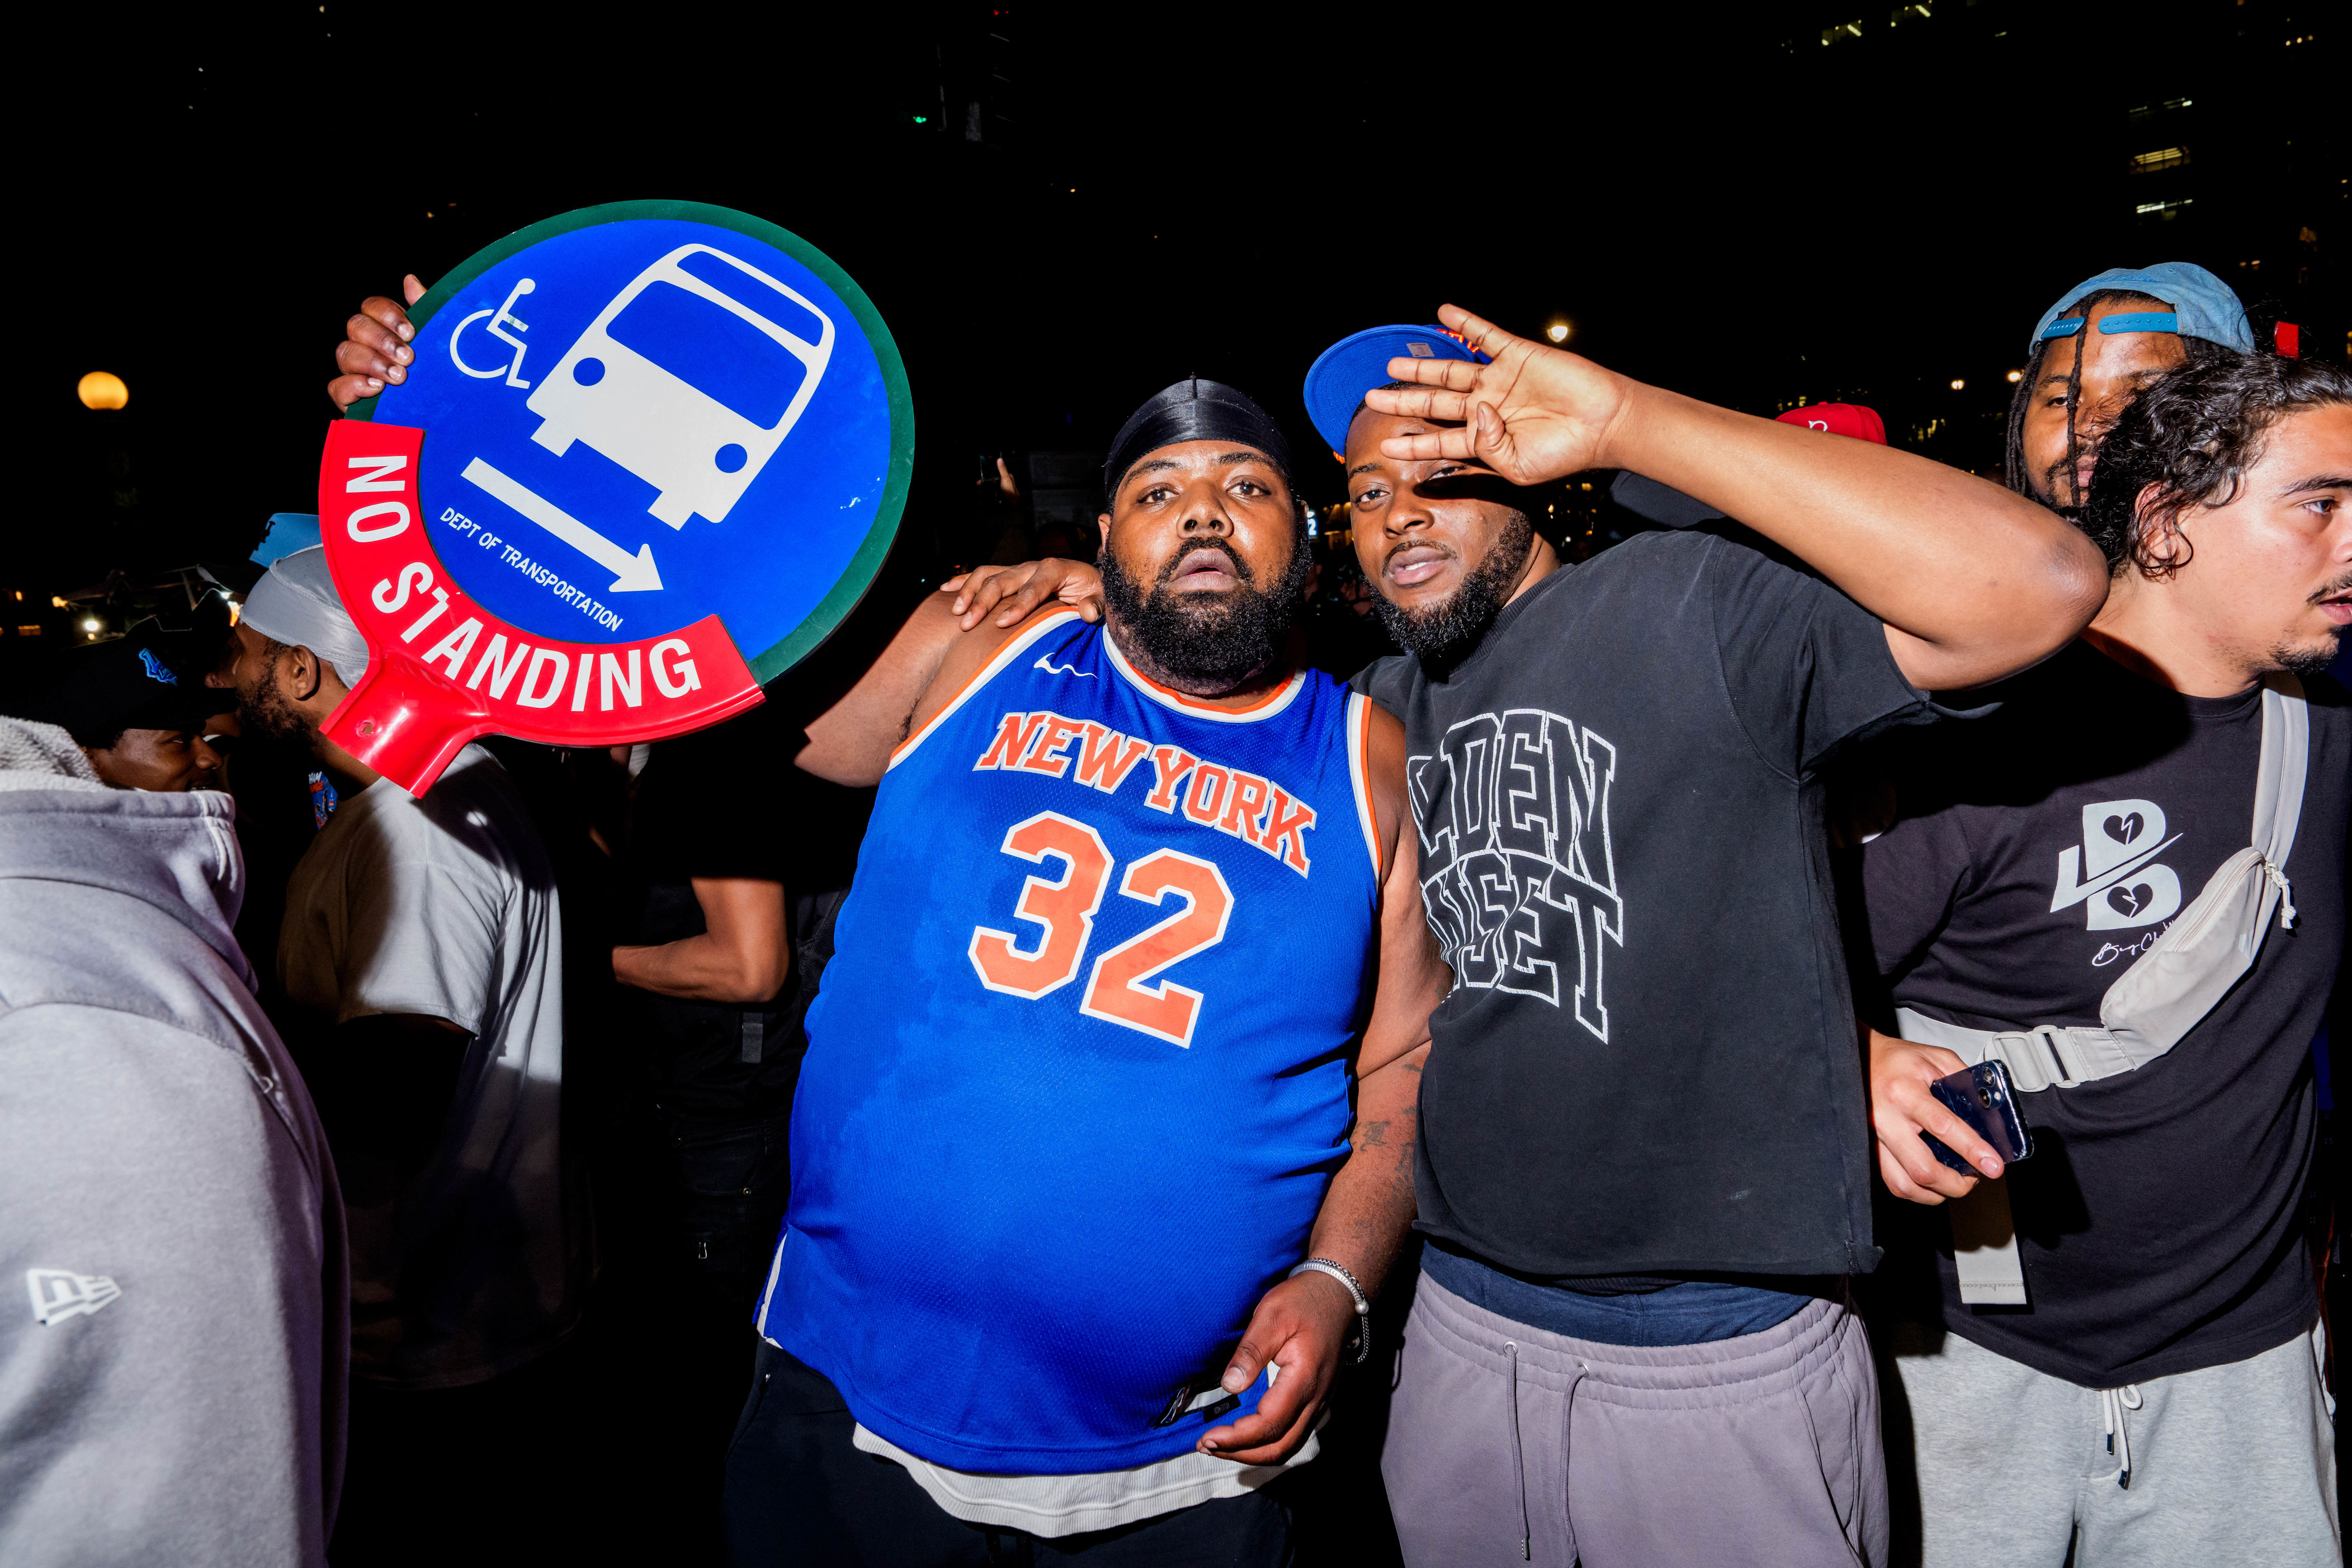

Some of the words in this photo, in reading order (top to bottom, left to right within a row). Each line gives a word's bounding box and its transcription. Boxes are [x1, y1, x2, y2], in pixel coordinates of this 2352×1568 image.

[346, 455, 410, 543] NO
[440, 507, 481, 538] DEPT
[479, 532, 503, 550] OF
[500, 544, 624, 632] TRANSPORTATION
[372, 561, 702, 712] STANDING
[973, 711, 1151, 794] NEW
[1144, 744, 1317, 879] YORK
[1406, 708, 1616, 898] LDEN
[968, 810, 1235, 1049] 32
